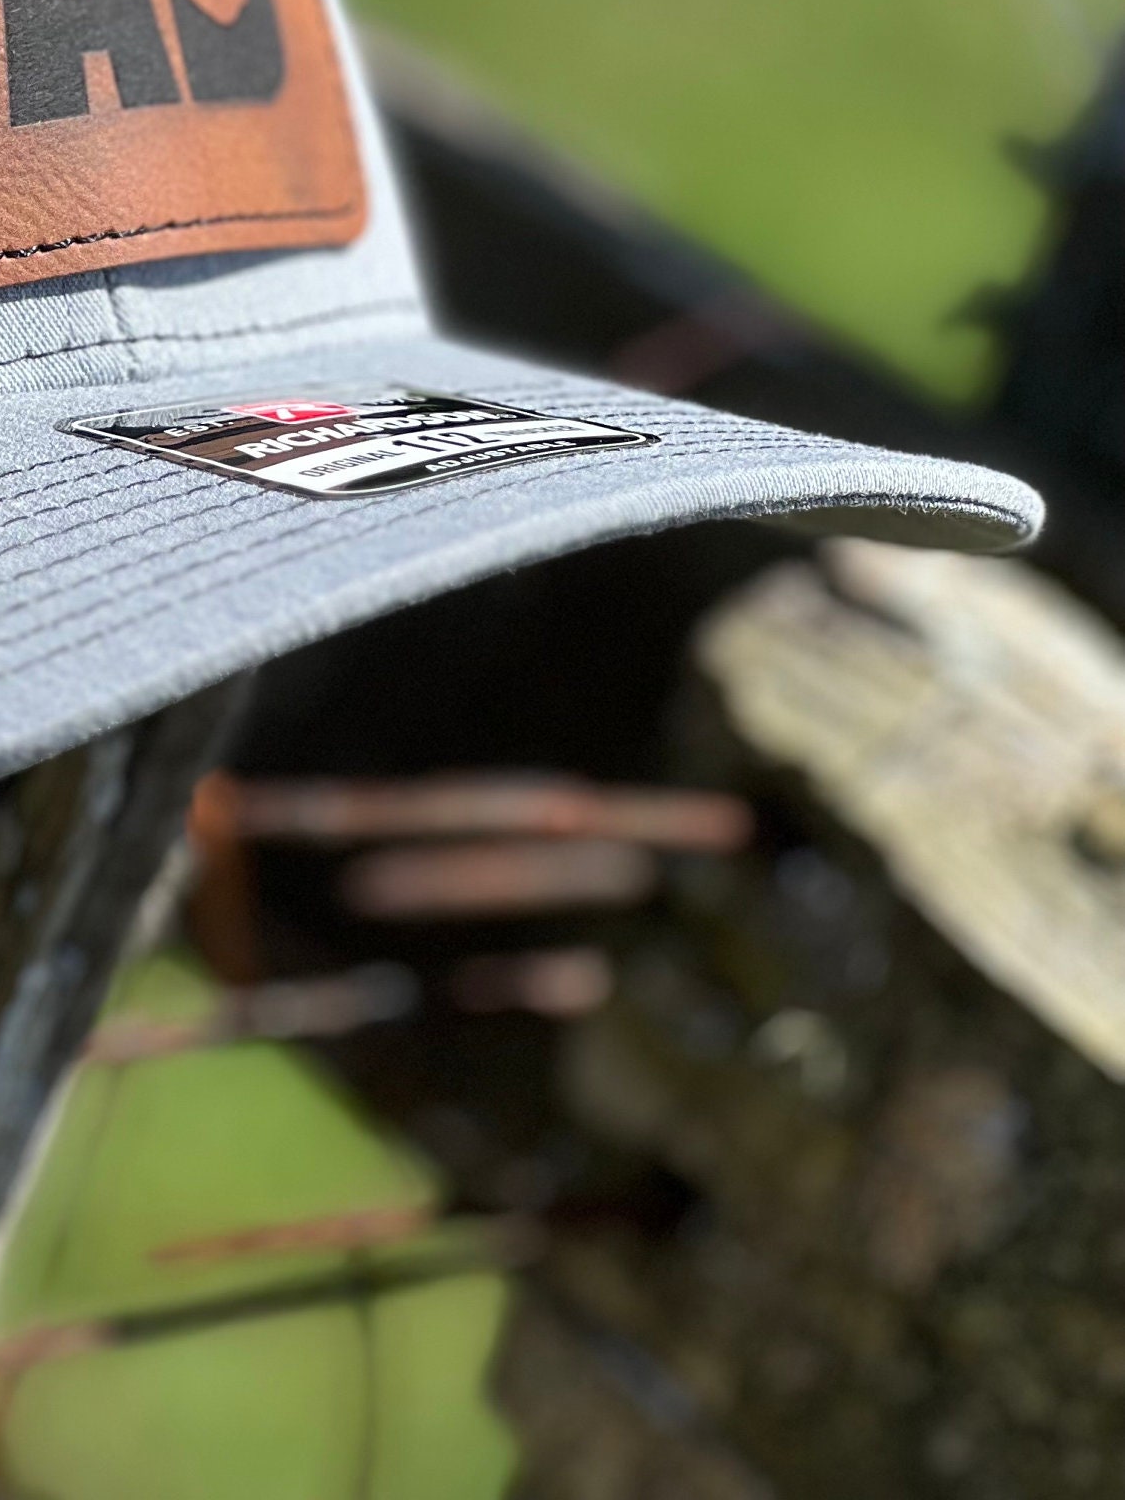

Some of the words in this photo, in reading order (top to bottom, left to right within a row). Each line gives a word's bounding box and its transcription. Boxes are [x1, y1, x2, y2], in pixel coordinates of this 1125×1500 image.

[163, 419, 234, 438] EST.
[233, 409, 499, 459] RICHARDSON
[298, 449, 407, 478] ORIGINAL
[392, 432, 502, 452] 112
[424, 439, 577, 473] ADJUSTABLE
